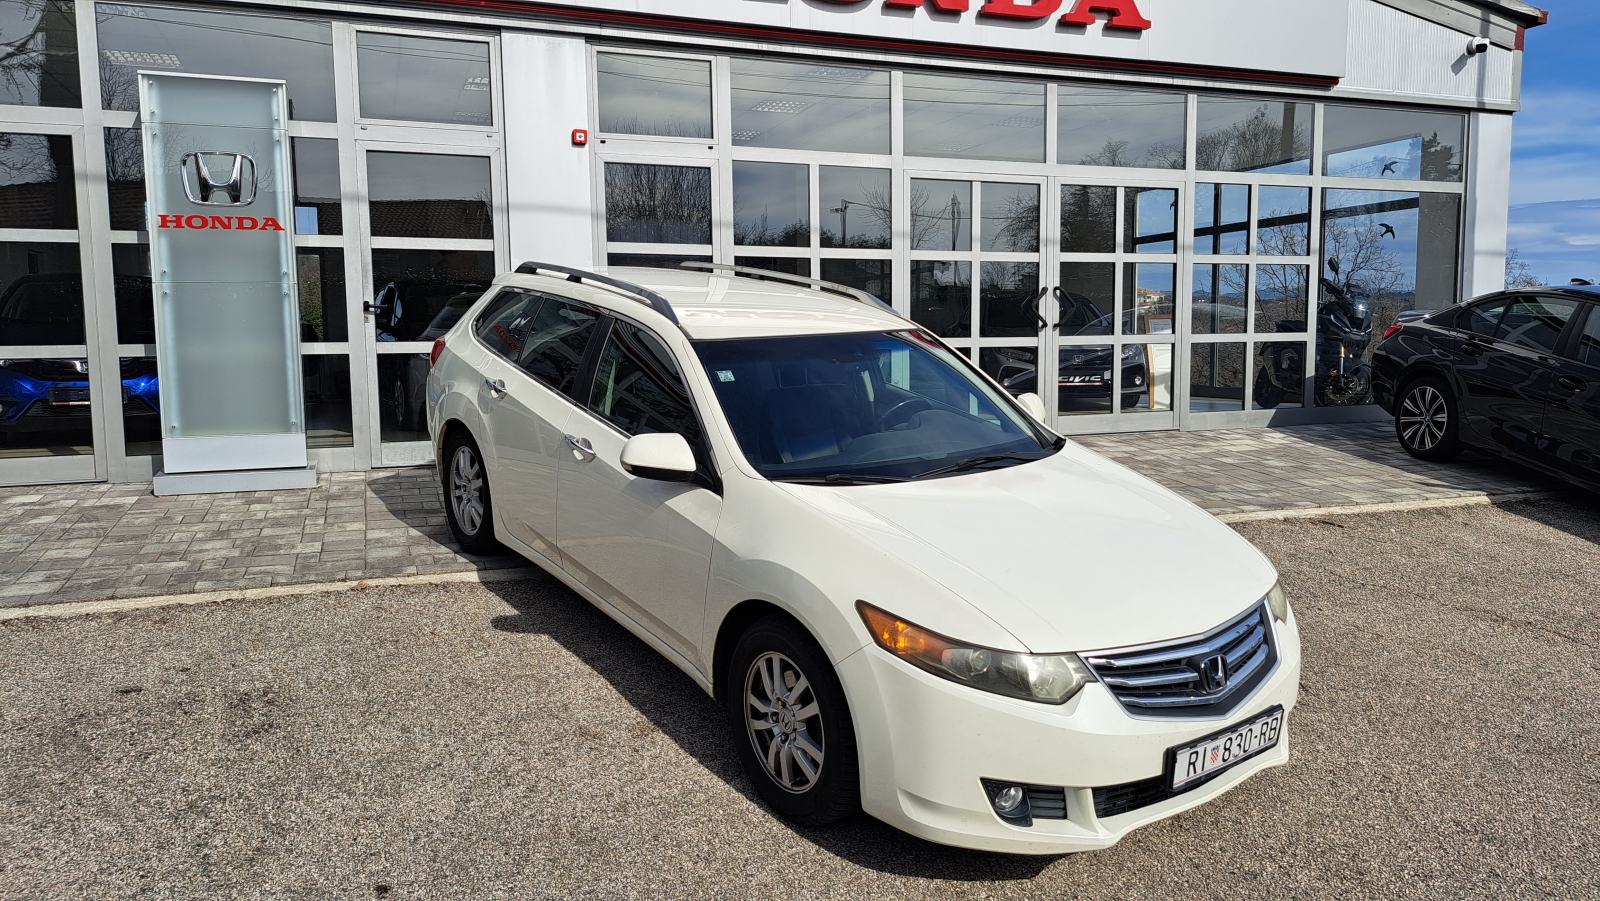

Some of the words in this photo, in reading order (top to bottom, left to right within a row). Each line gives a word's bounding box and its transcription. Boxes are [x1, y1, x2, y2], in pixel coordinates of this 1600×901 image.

[158, 214, 285, 231] HONDA
[1186, 746, 1207, 777] RI
[1221, 716, 1279, 763] 830-RB
